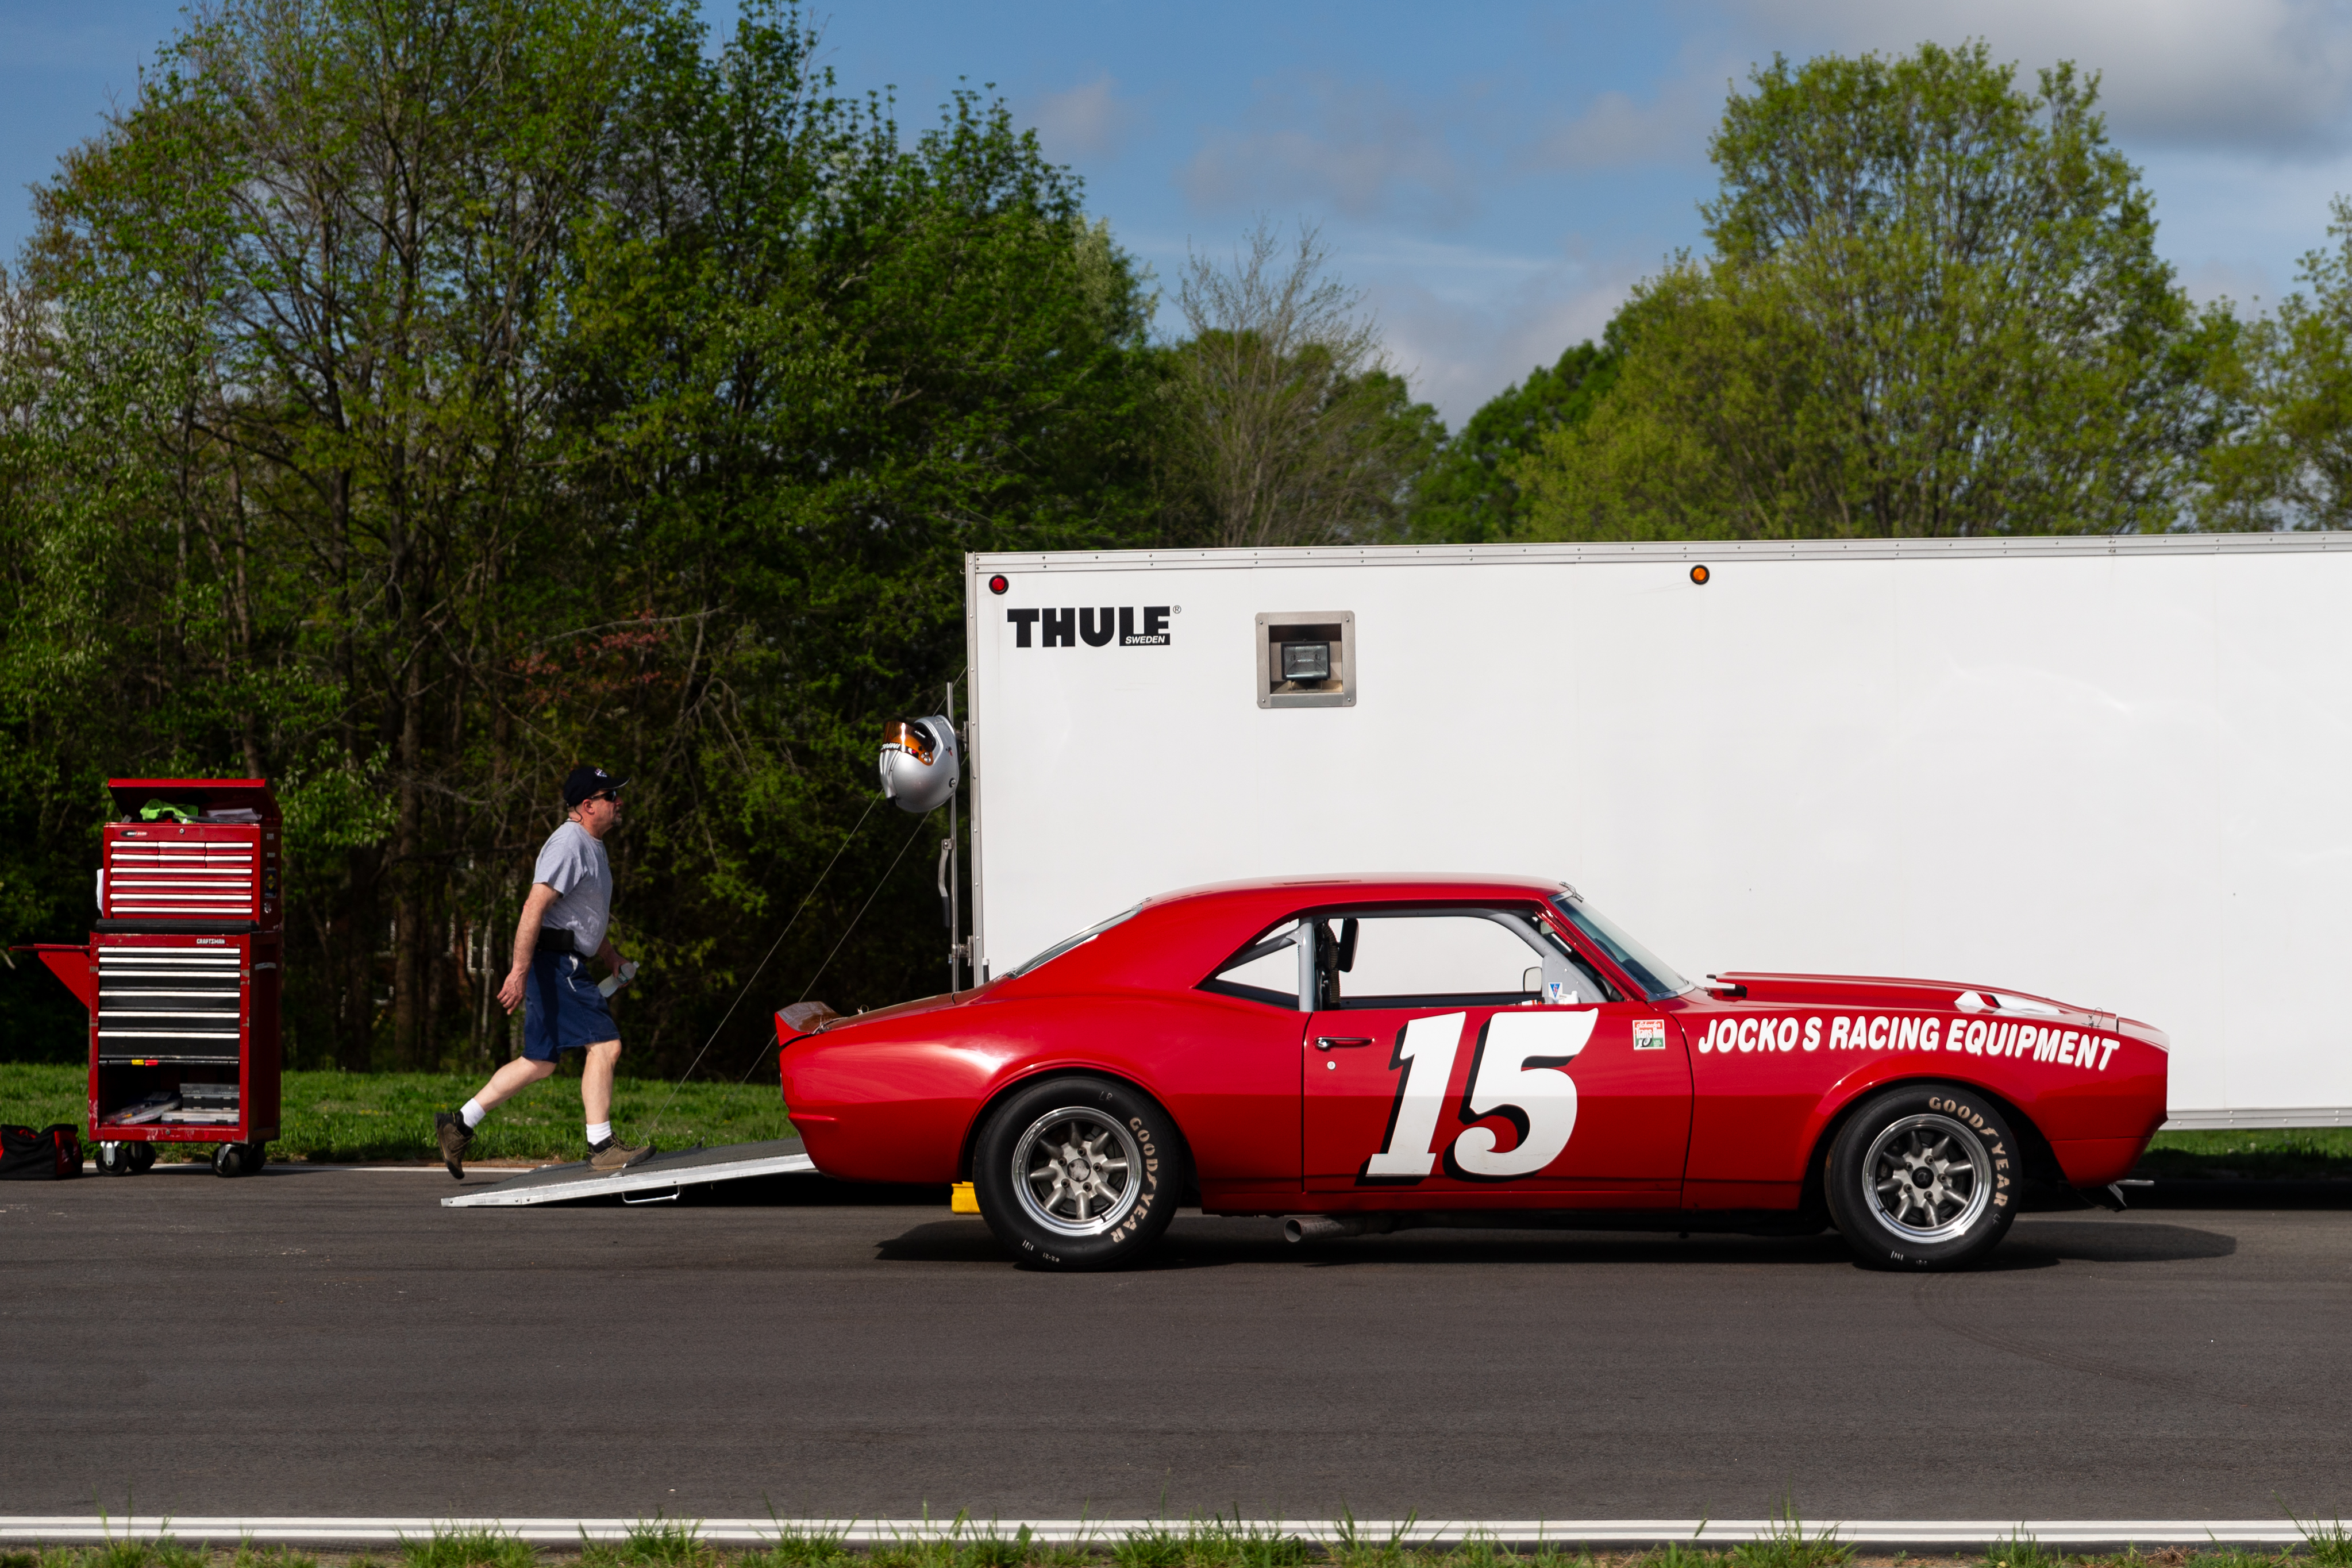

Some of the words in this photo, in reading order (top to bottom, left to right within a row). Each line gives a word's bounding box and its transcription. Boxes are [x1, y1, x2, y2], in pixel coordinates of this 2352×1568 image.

[1007, 606, 1171, 648] THULE
[1125, 635, 1165, 644] SWEDEN
[1829, 1015, 1941, 1051] RACING
[1945, 1018, 2121, 1072] EQUIPMENT
[1354, 1007, 1599, 1186] 15
